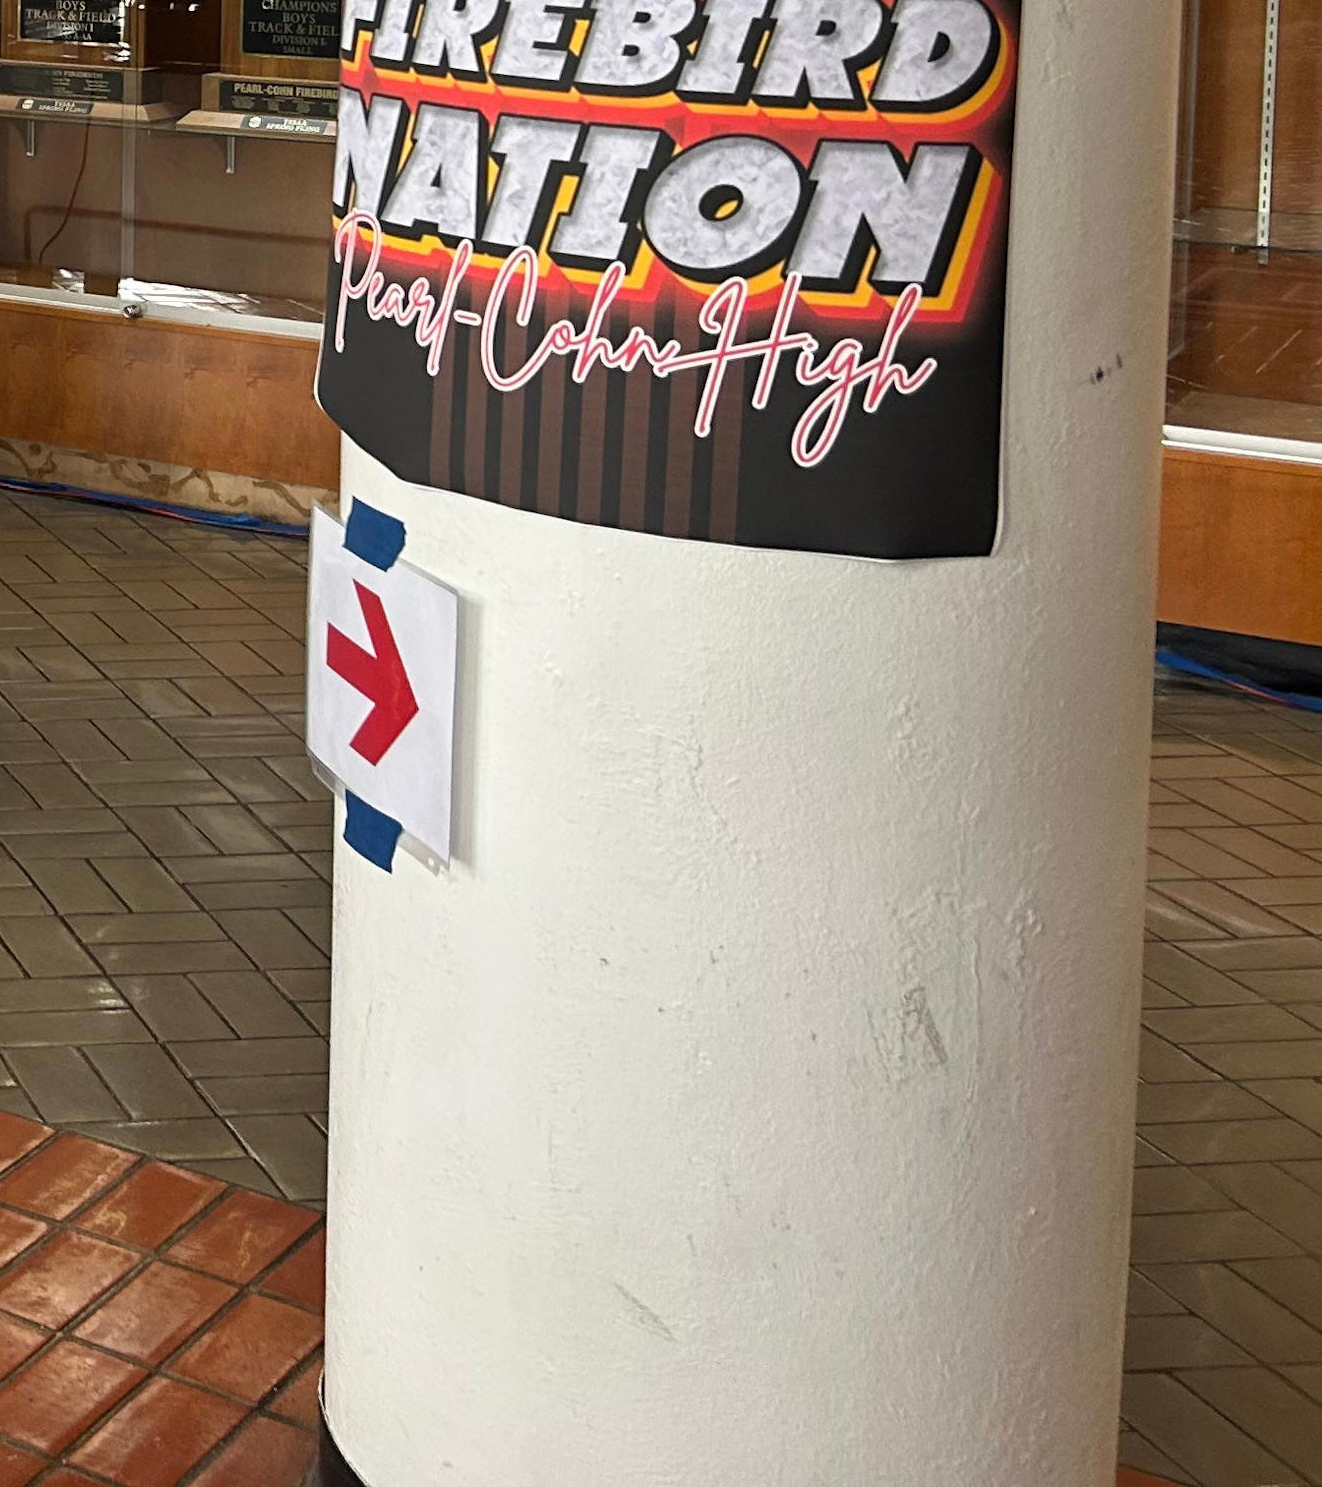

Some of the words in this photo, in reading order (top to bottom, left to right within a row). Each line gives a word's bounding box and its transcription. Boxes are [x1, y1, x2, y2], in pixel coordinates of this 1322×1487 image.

[55, 0, 87, 11] BOYS
[26, 8, 66, 21] TRACK
[67, 10, 77, 21] &
[78, 11, 117, 23] FIELD
[282, 11, 317, 25] BOYS
[248, 20, 295, 34] TRACK
[296, 24, 307, 34] &
[308, 23, 339, 37] FIEL
[271, 34, 318, 46] DIVISION
[233, 82, 295, 97] PEARL-COHN
[333, 89, 984, 296] NATION
[333, 209, 681, 392] Pearl-Cohn
[656, 270, 938, 467] High
